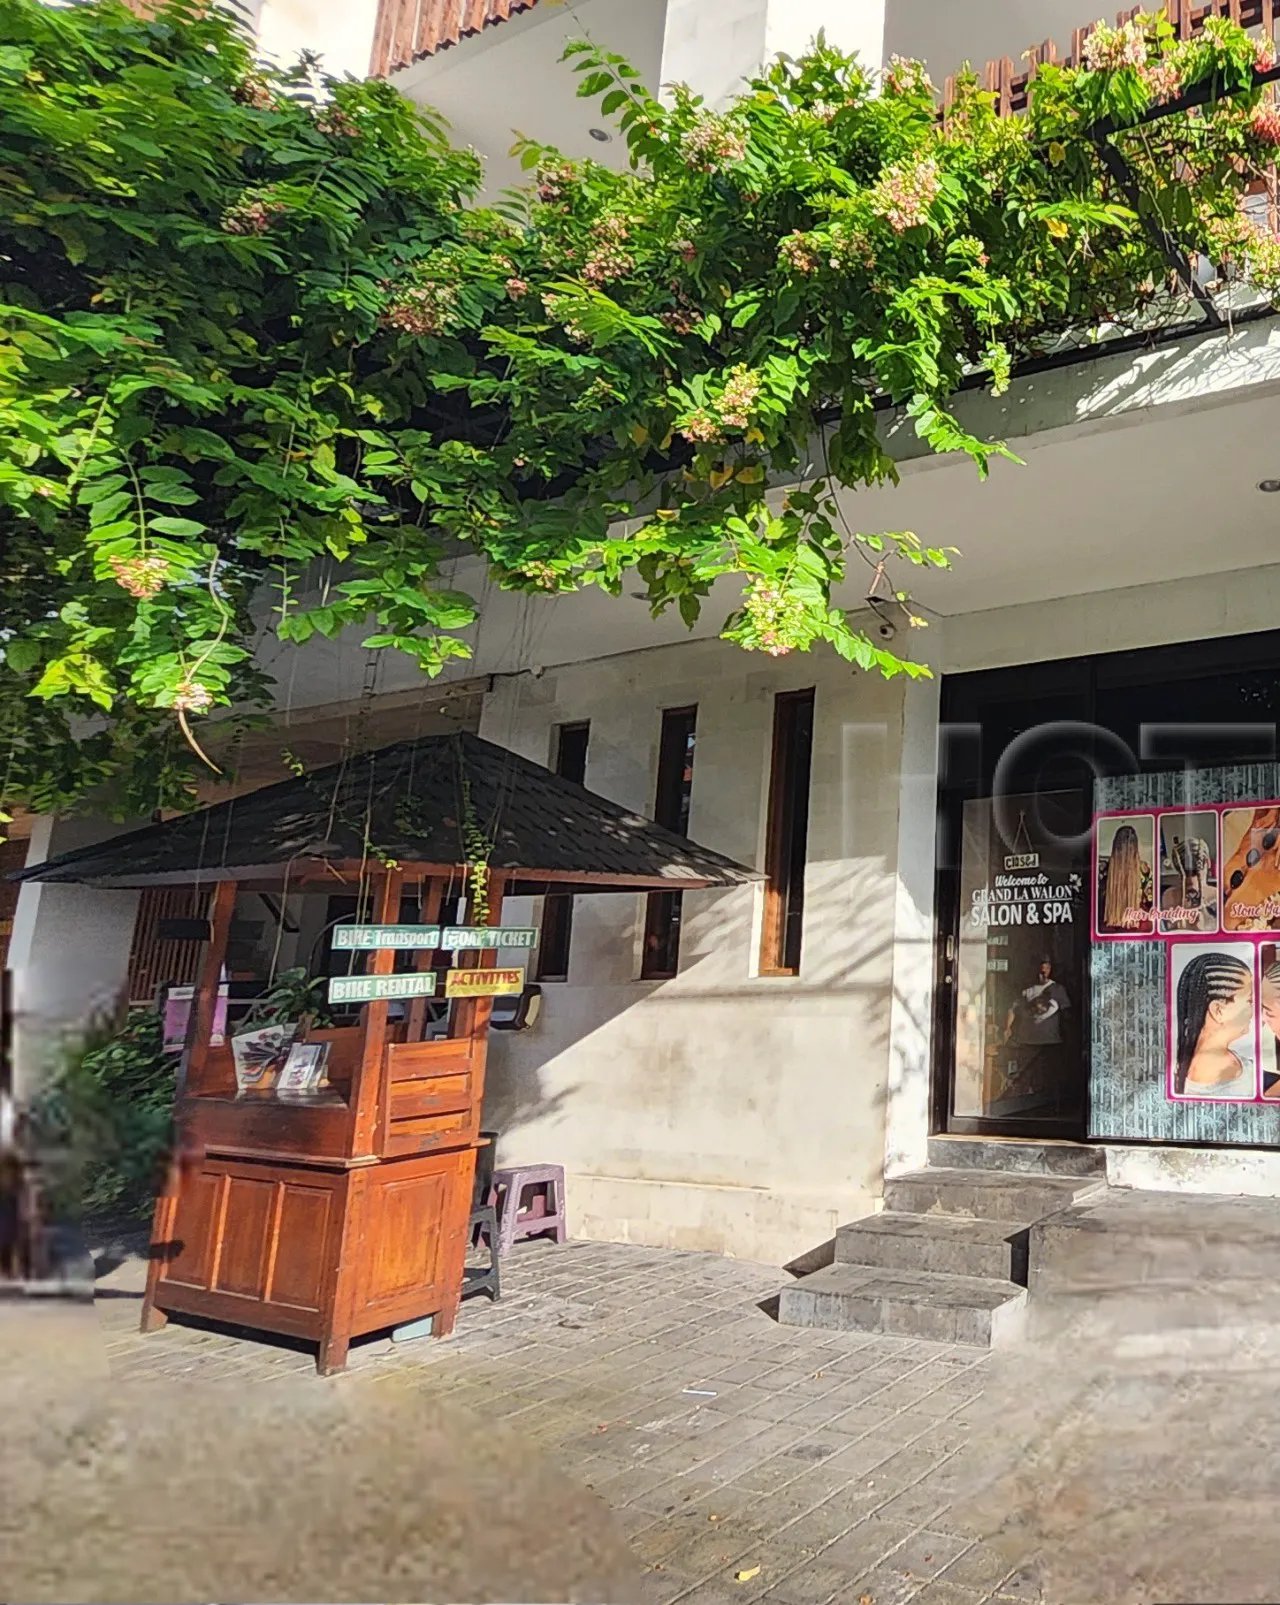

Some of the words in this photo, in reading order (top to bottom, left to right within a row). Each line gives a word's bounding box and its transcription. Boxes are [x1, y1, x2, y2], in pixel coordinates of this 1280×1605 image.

[995, 875, 1036, 887] Welcome
[1037, 873, 1049, 885] to
[972, 888, 1012, 903] GRAND
[1014, 888, 1029, 900] LA
[1031, 885, 1072, 899] WALON
[971, 904, 1022, 926] SALON
[1026, 903, 1040, 924] &
[1043, 902, 1073, 924] SPA
[1123, 907, 1147, 921] Hair
[1148, 906, 1200, 924] Braiding
[1231, 903, 1260, 917] Stone
[336, 929, 371, 946] BIKE
[374, 928, 439, 946] Transport
[487, 931, 533, 947] TICKET
[450, 970, 521, 986] ACTIVITIES
[333, 979, 371, 999] BIKE
[375, 976, 433, 996] RENTAL
